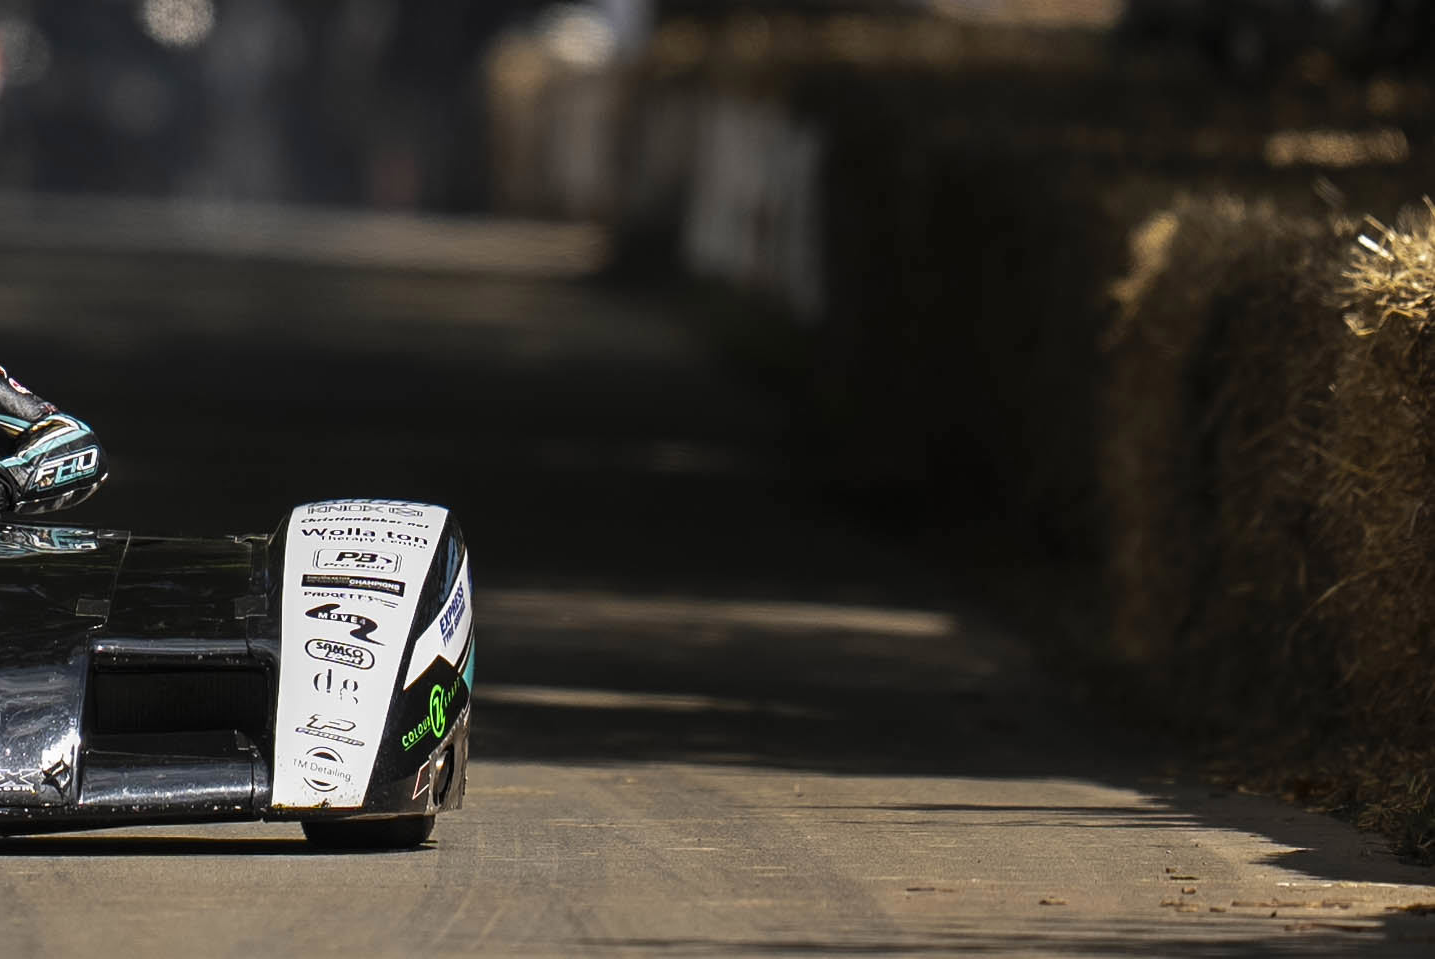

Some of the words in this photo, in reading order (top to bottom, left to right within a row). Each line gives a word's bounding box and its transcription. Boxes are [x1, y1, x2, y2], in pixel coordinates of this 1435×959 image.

[348, 579, 400, 591] CHAMPIONS
[440, 585, 463, 636] EXPRESS
[402, 716, 431, 747] COLOUR
[310, 762, 351, 782] Detailing
